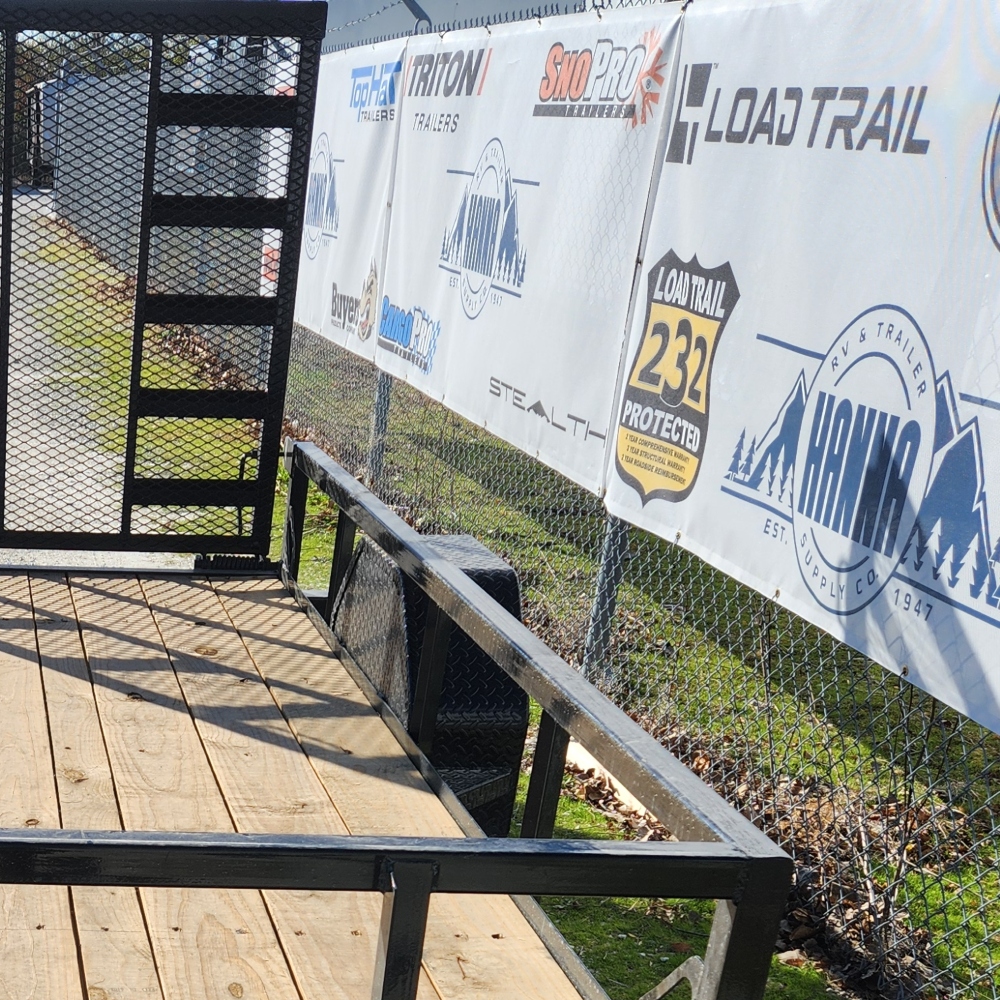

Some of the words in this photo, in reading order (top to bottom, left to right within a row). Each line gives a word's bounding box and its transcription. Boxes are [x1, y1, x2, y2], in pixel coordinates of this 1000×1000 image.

[407, 48, 485, 98] TRITON
[413, 112, 460, 133] TRAILERS
[564, 104, 627, 118] TRAILERS
[704, 86, 803, 146] LOAD
[806, 85, 931, 154] TRAIL
[653, 266, 690, 309] LOAD
[690, 276, 727, 318] TRAIL
[637, 317, 708, 408] 232
[831, 341, 850, 372] RV
[859, 327, 866, 343] &
[877, 322, 927, 398] TRAILER
[622, 400, 701, 453] PROTECTED
[797, 390, 921, 559] HANNA
[763, 518, 788, 545] EST.
[800, 532, 846, 600] SUPPLY
[894, 588, 934, 622] 1947
